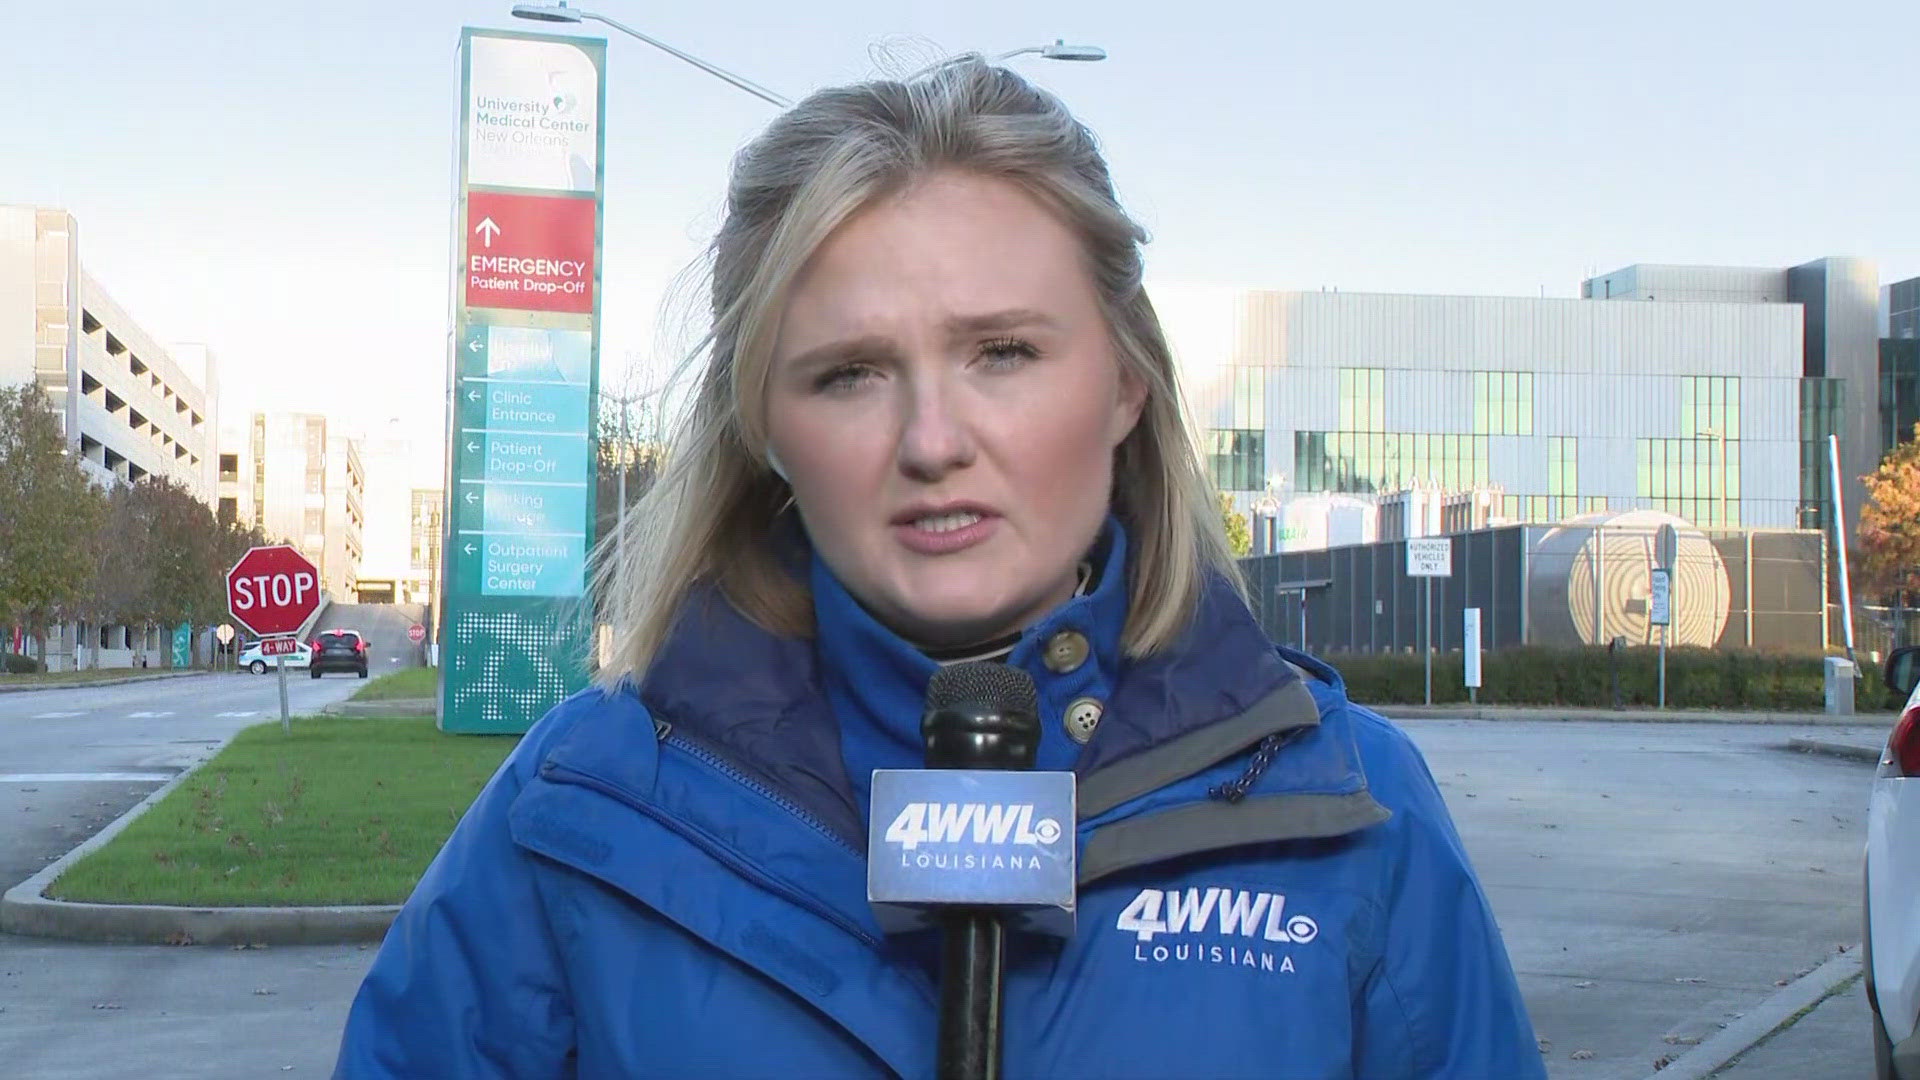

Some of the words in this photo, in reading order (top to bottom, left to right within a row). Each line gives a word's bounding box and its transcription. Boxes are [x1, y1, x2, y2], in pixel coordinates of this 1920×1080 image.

[477, 96, 549, 115] University
[477, 112, 535, 128] Medical
[539, 117, 590, 132] Center
[476, 128, 507, 142] New
[512, 130, 569, 147] Orleans
[471, 255, 585, 277] EMERGENCY
[471, 276, 519, 291] Patient
[523, 279, 585, 295] Drop-Off
[492, 390, 532, 405] Clinic
[492, 407, 556, 422] Entrance
[491, 441, 543, 456] Patient
[490, 458, 556, 474] Drop-Off
[490, 489, 543, 509] king
[488, 542, 568, 558] Outpatient
[1410, 543, 1448, 551] AUTHORIZED
[1414, 553, 1444, 561] VEHICLES
[488, 560, 543, 576] Surgery
[1420, 562, 1439, 570] ONLY
[235, 572, 314, 610] STOP
[487, 576, 536, 590] Center
[263, 641, 296, 654] 4-WAY
[885, 803, 1038, 850] 4WWL
[901, 852, 1042, 870] LOUISIANA
[1117, 887, 1292, 942] 4WWL
[1135, 944, 1295, 973] LOUISIANA
